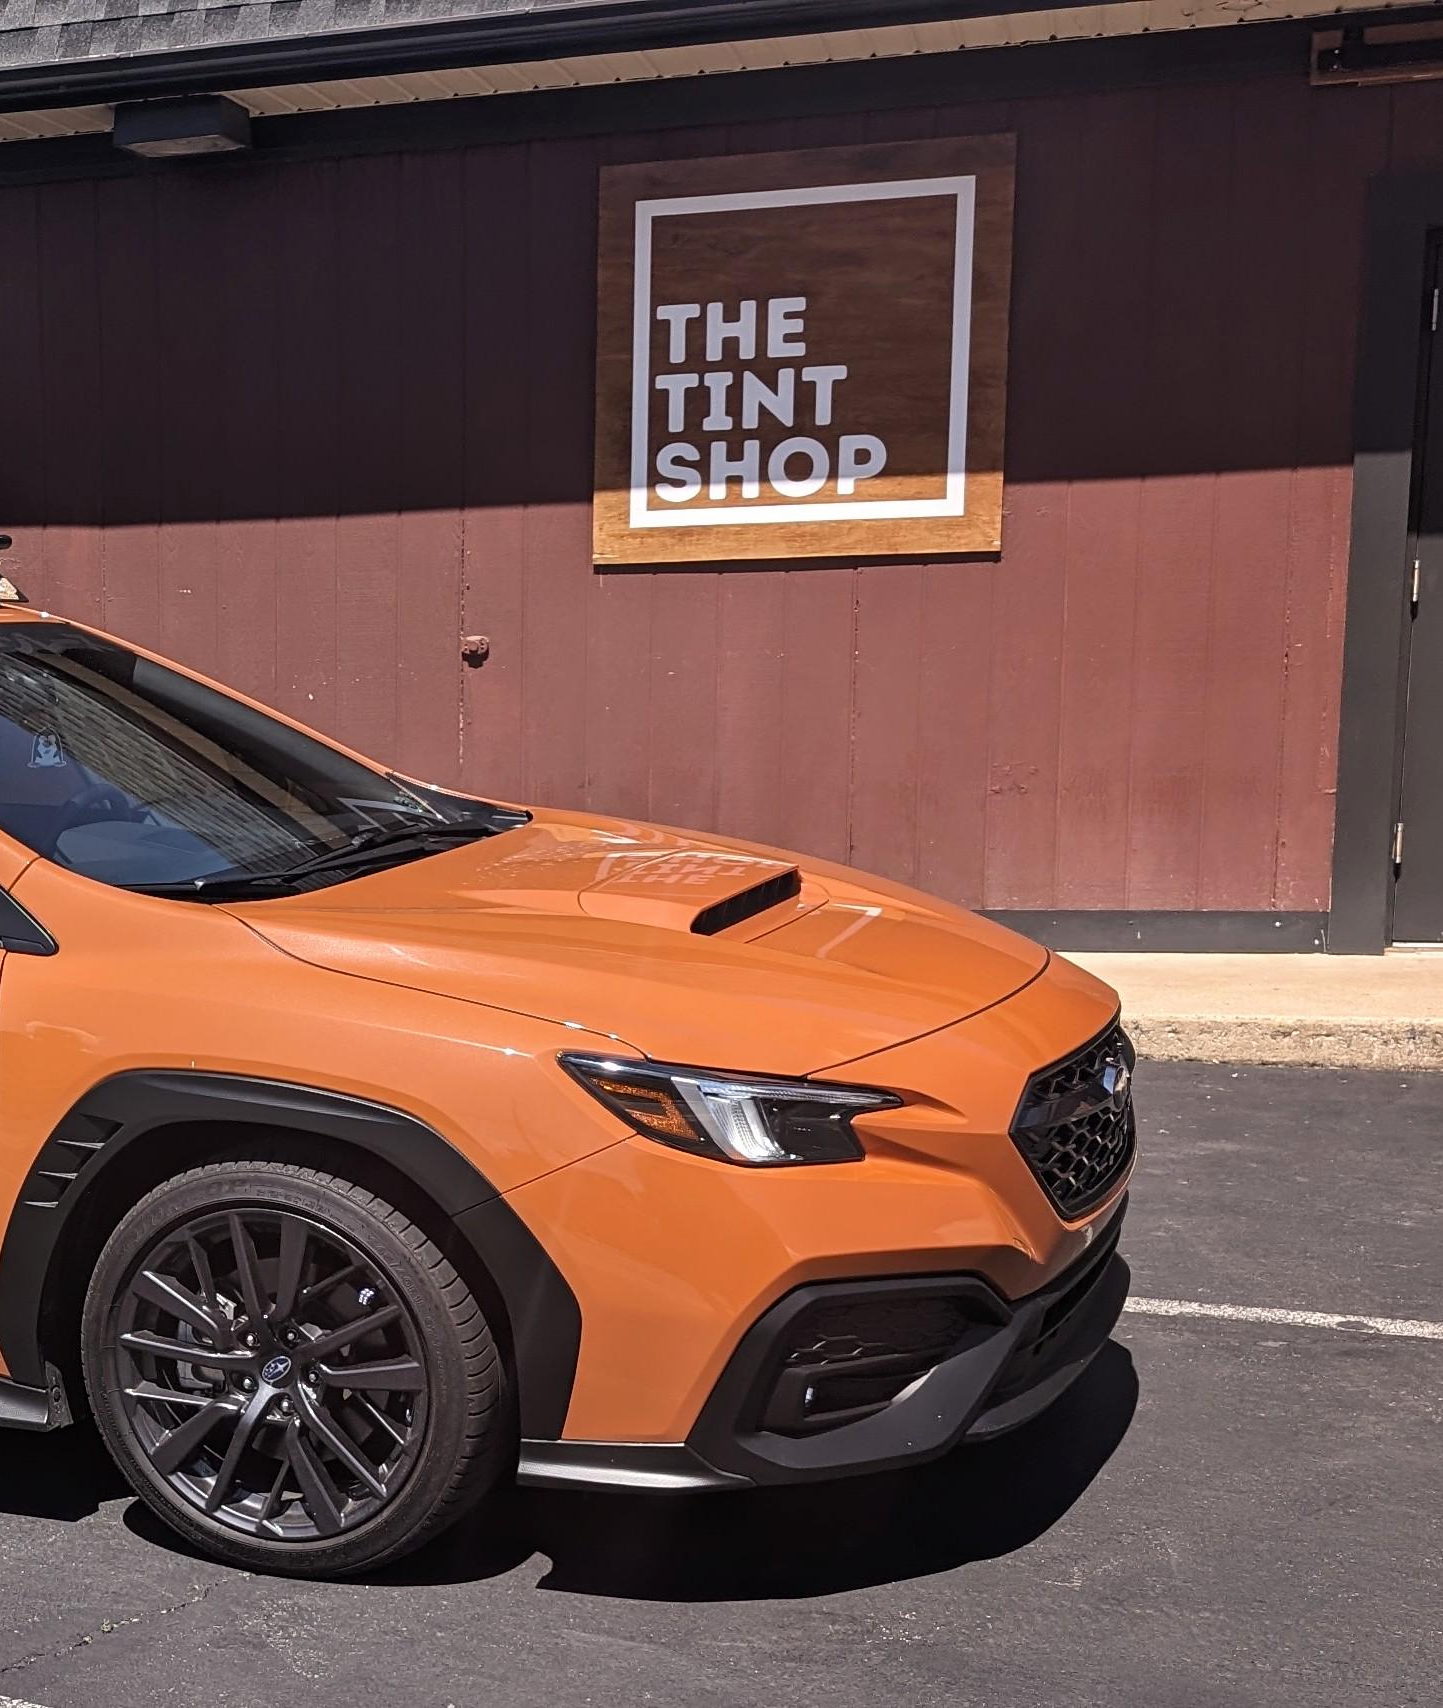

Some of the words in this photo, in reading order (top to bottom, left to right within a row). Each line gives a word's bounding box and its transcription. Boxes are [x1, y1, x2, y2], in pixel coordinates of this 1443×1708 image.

[657, 297, 806, 363] THE
[655, 365, 847, 432] TINT
[655, 434, 887, 502] SHOP
